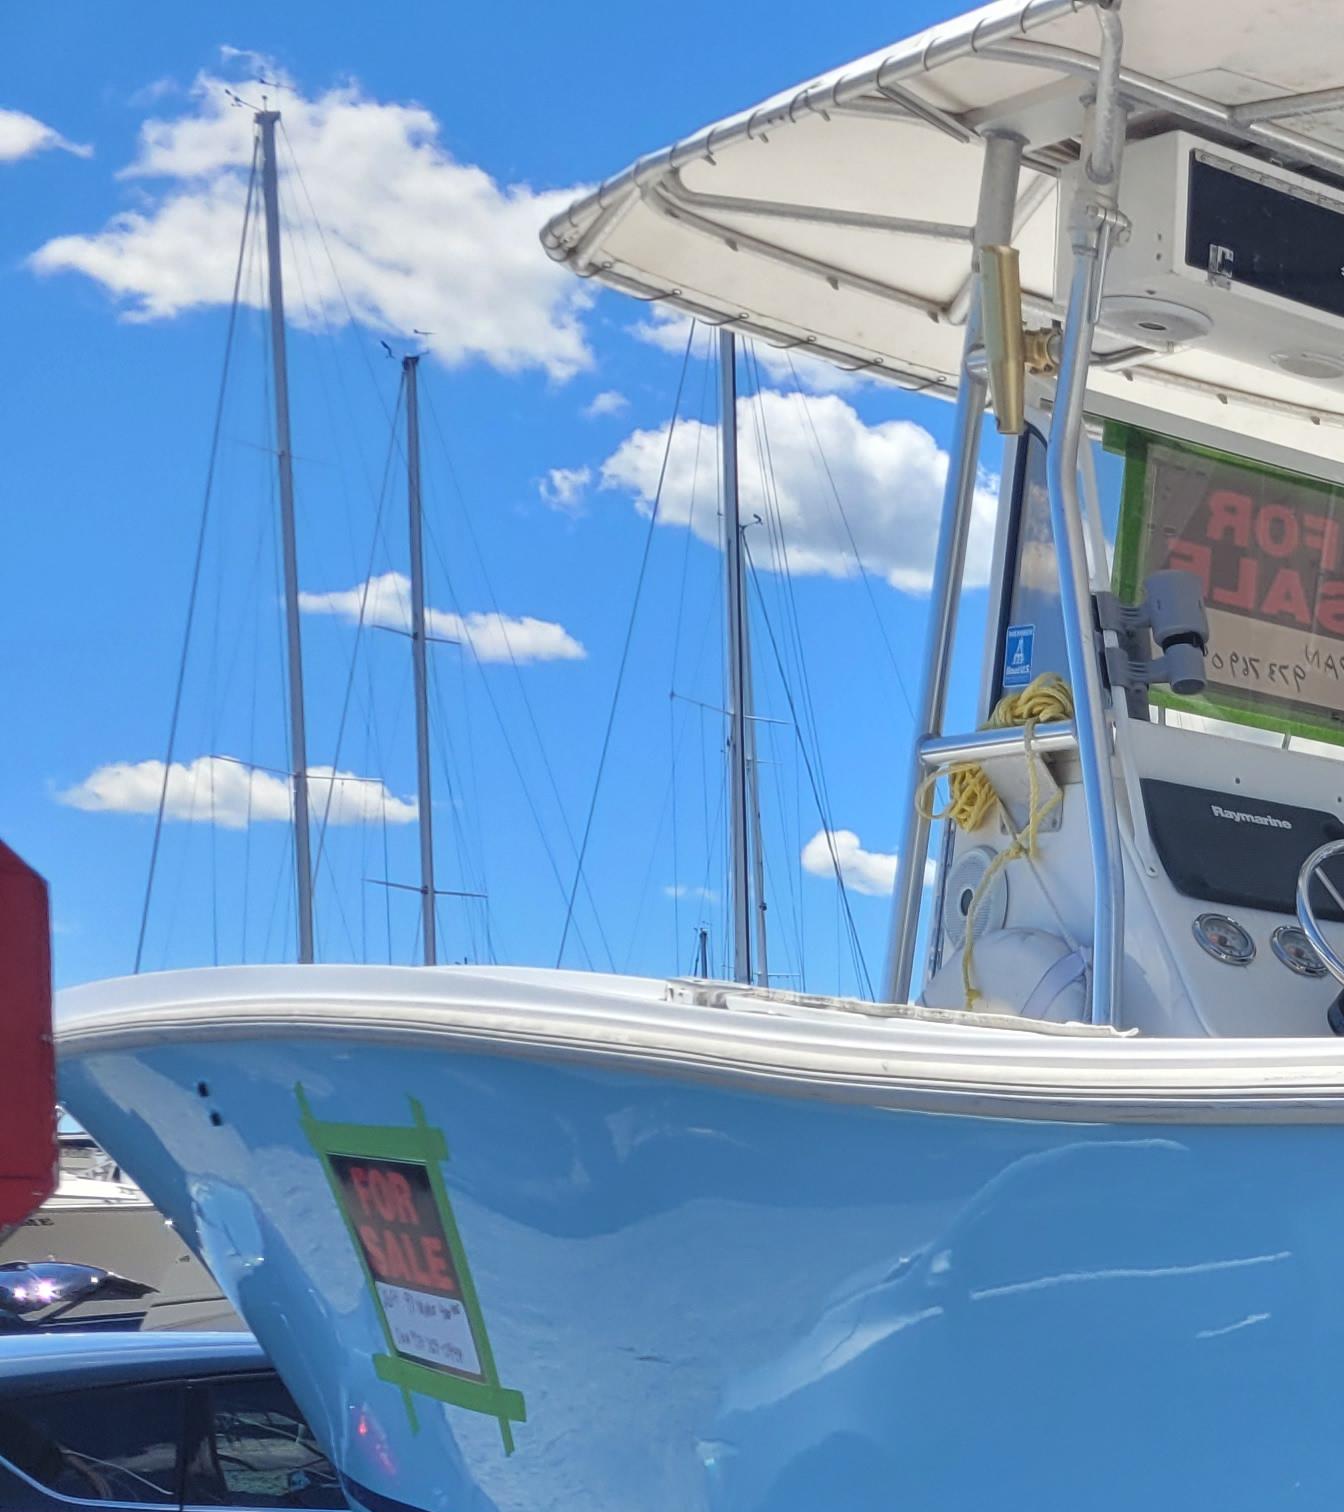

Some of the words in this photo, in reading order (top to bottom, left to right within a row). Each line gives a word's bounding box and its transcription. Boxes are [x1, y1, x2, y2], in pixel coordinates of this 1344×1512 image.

[1211, 805, 1292, 829] Raymarine
[349, 1166, 419, 1225] FOR
[359, 1225, 456, 1291] SALE
